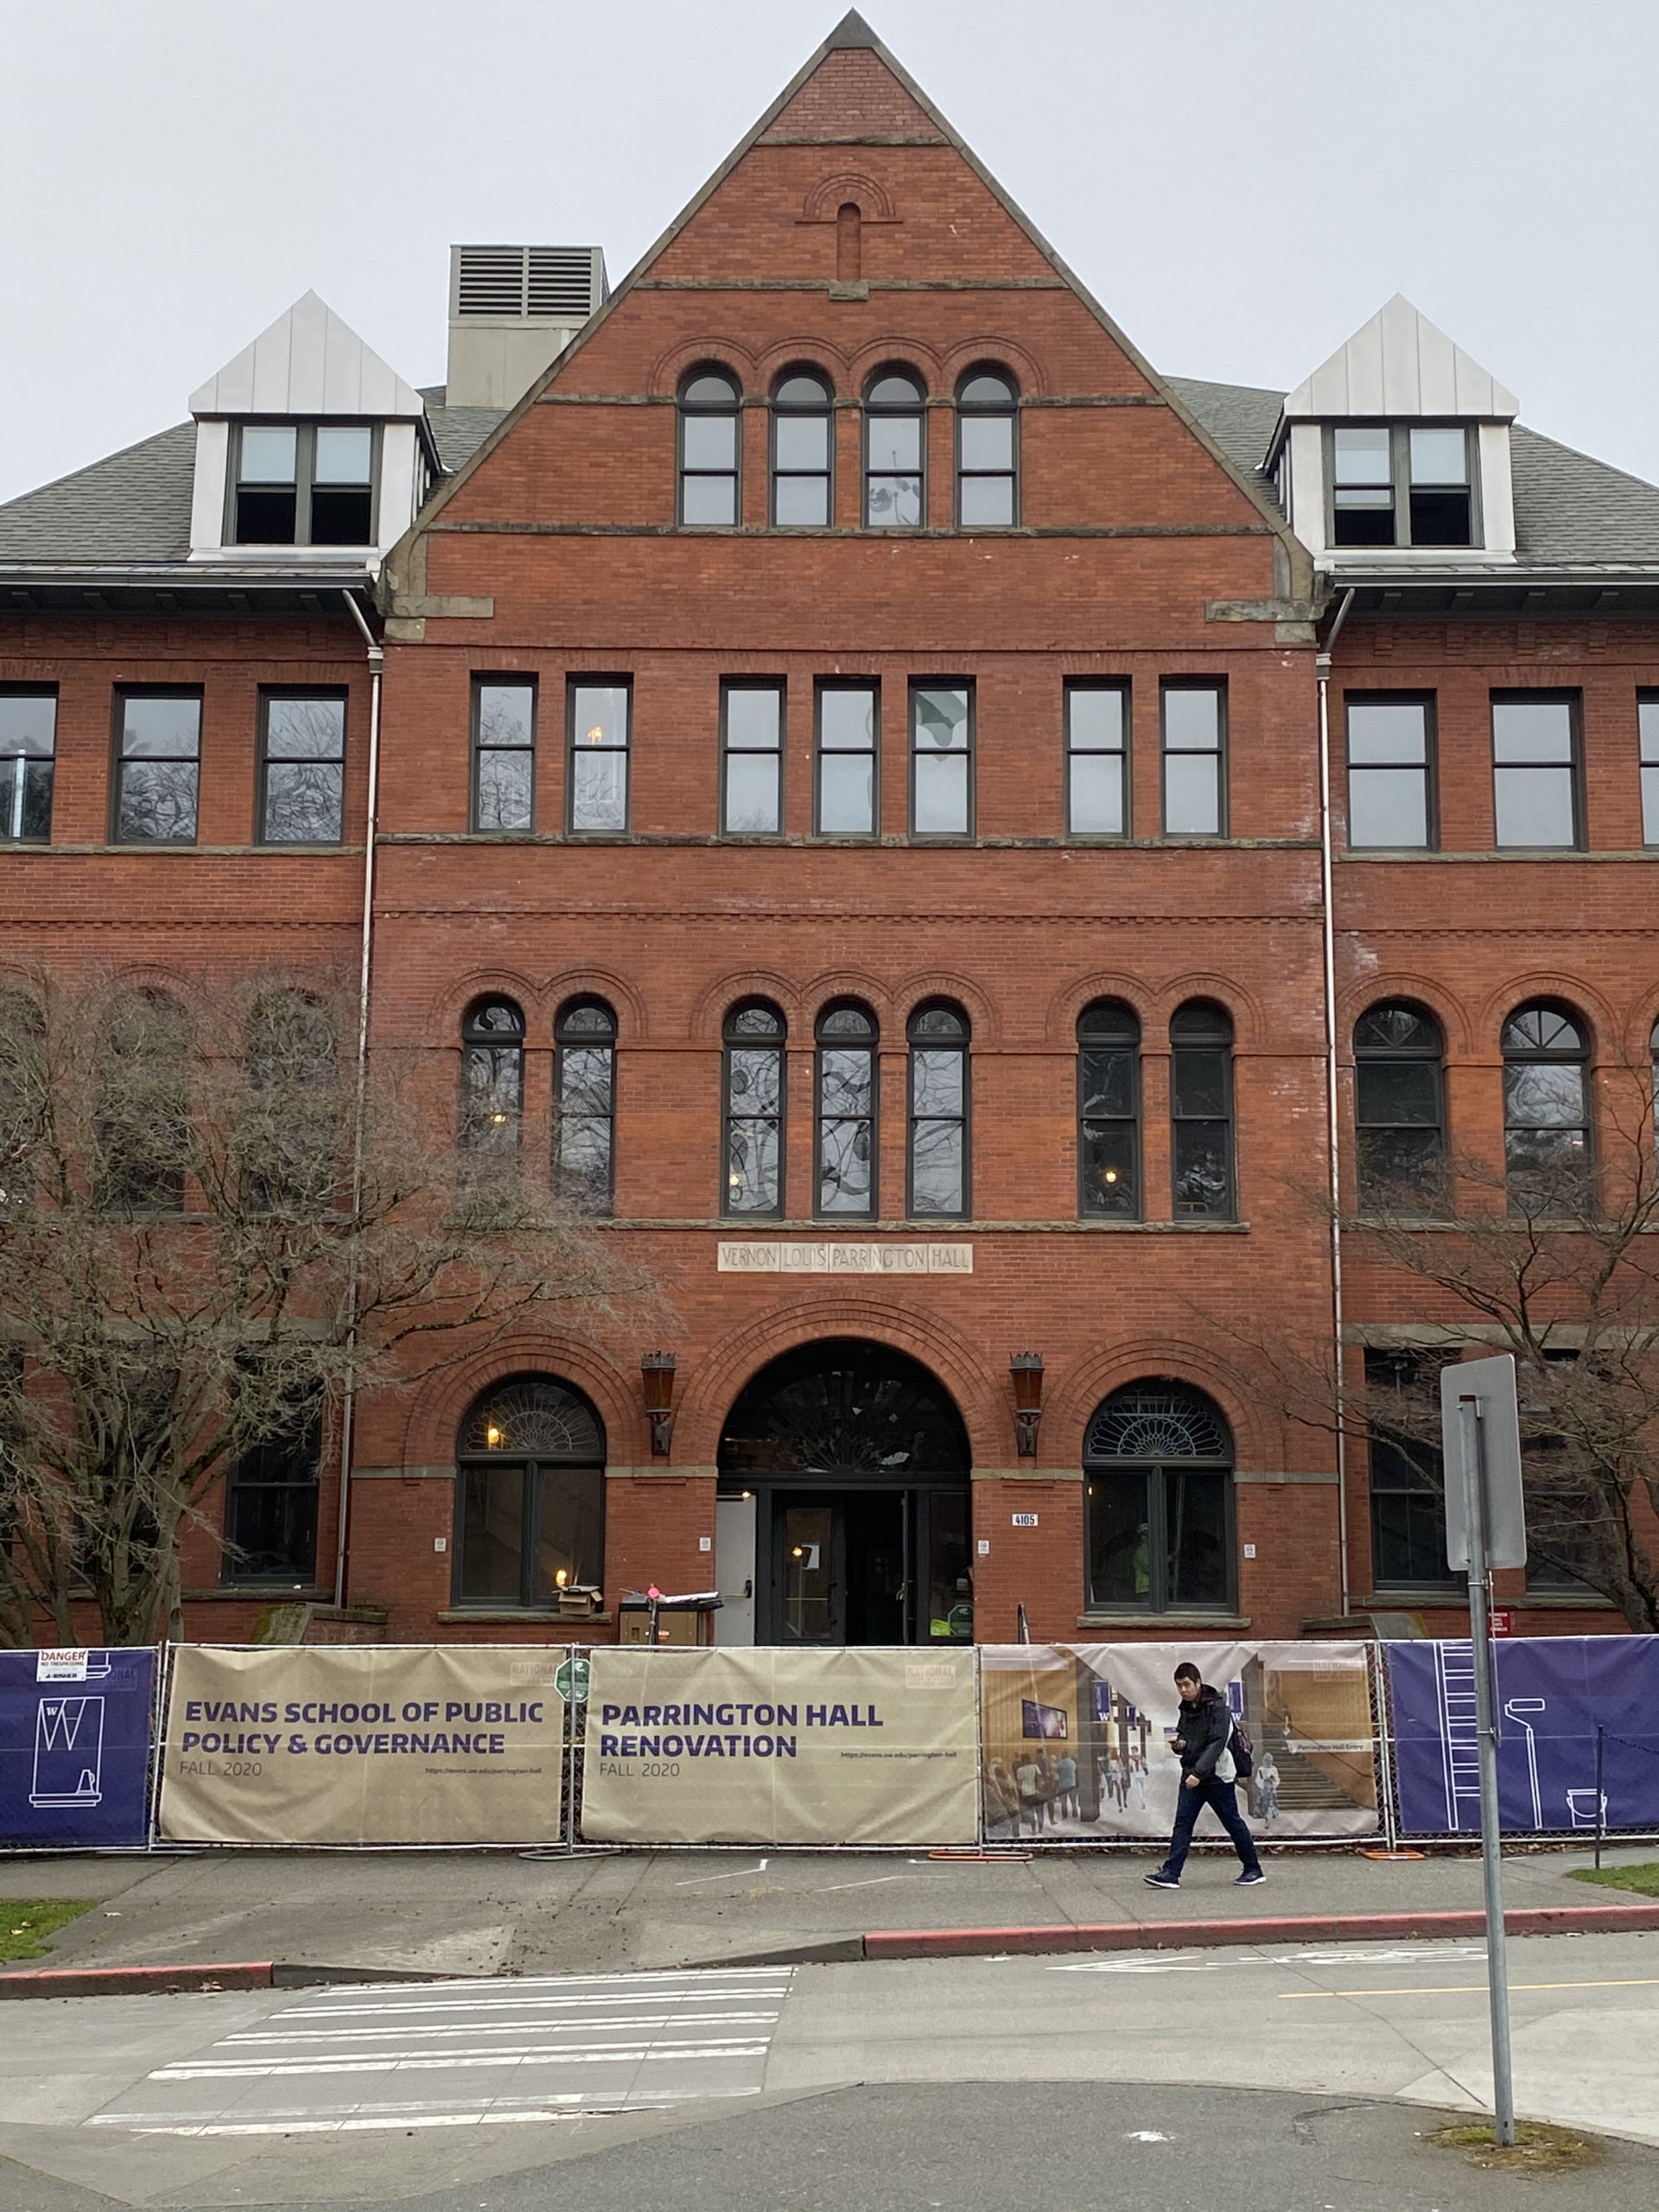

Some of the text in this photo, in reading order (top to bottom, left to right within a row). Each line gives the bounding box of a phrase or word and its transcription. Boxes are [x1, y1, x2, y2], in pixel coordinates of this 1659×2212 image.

[721, 1247, 969, 1268] VERNON LOUIS PARRINGTON HALL
[1014, 1515, 1035, 1526] 4105
[41, 1651, 86, 1661] DANGER
[185, 1700, 543, 1724] EVANS SCHOOL OF PUBLIC
[601, 1703, 884, 1726] PARRINGTON HALL
[181, 1732, 505, 1755] POLICY & GOVERNANCE
[601, 1734, 797, 1758] RENOVATION
[180, 1761, 263, 1777] FALL 2020
[600, 1763, 680, 1777] FALL 2020
